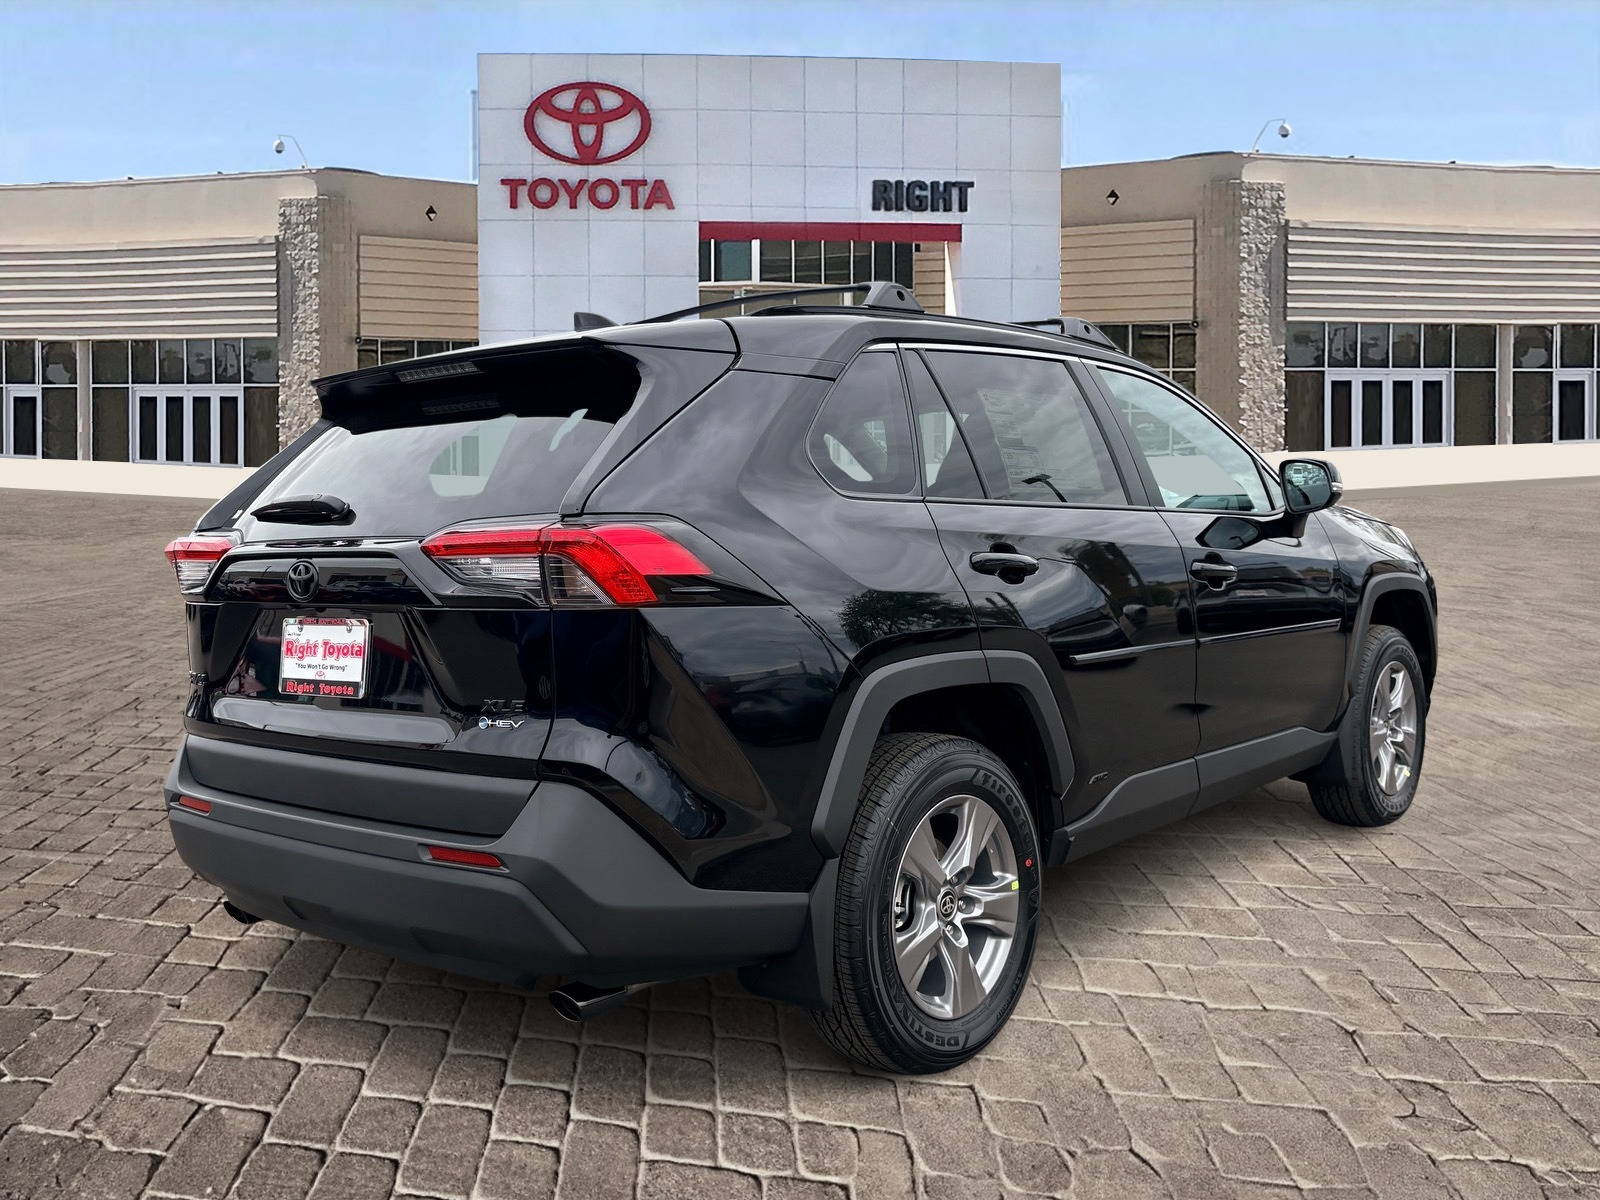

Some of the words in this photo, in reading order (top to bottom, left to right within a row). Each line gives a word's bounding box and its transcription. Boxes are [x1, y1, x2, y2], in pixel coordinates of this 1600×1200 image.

[500, 177, 675, 210] TOYOTA
[872, 179, 975, 212] RIGHT
[285, 639, 318, 660] Right
[321, 640, 364, 660] Toyota
[286, 680, 315, 694] Right
[319, 682, 354, 695] Toyota
[481, 699, 526, 712] XLE
[488, 719, 525, 728] HEV
